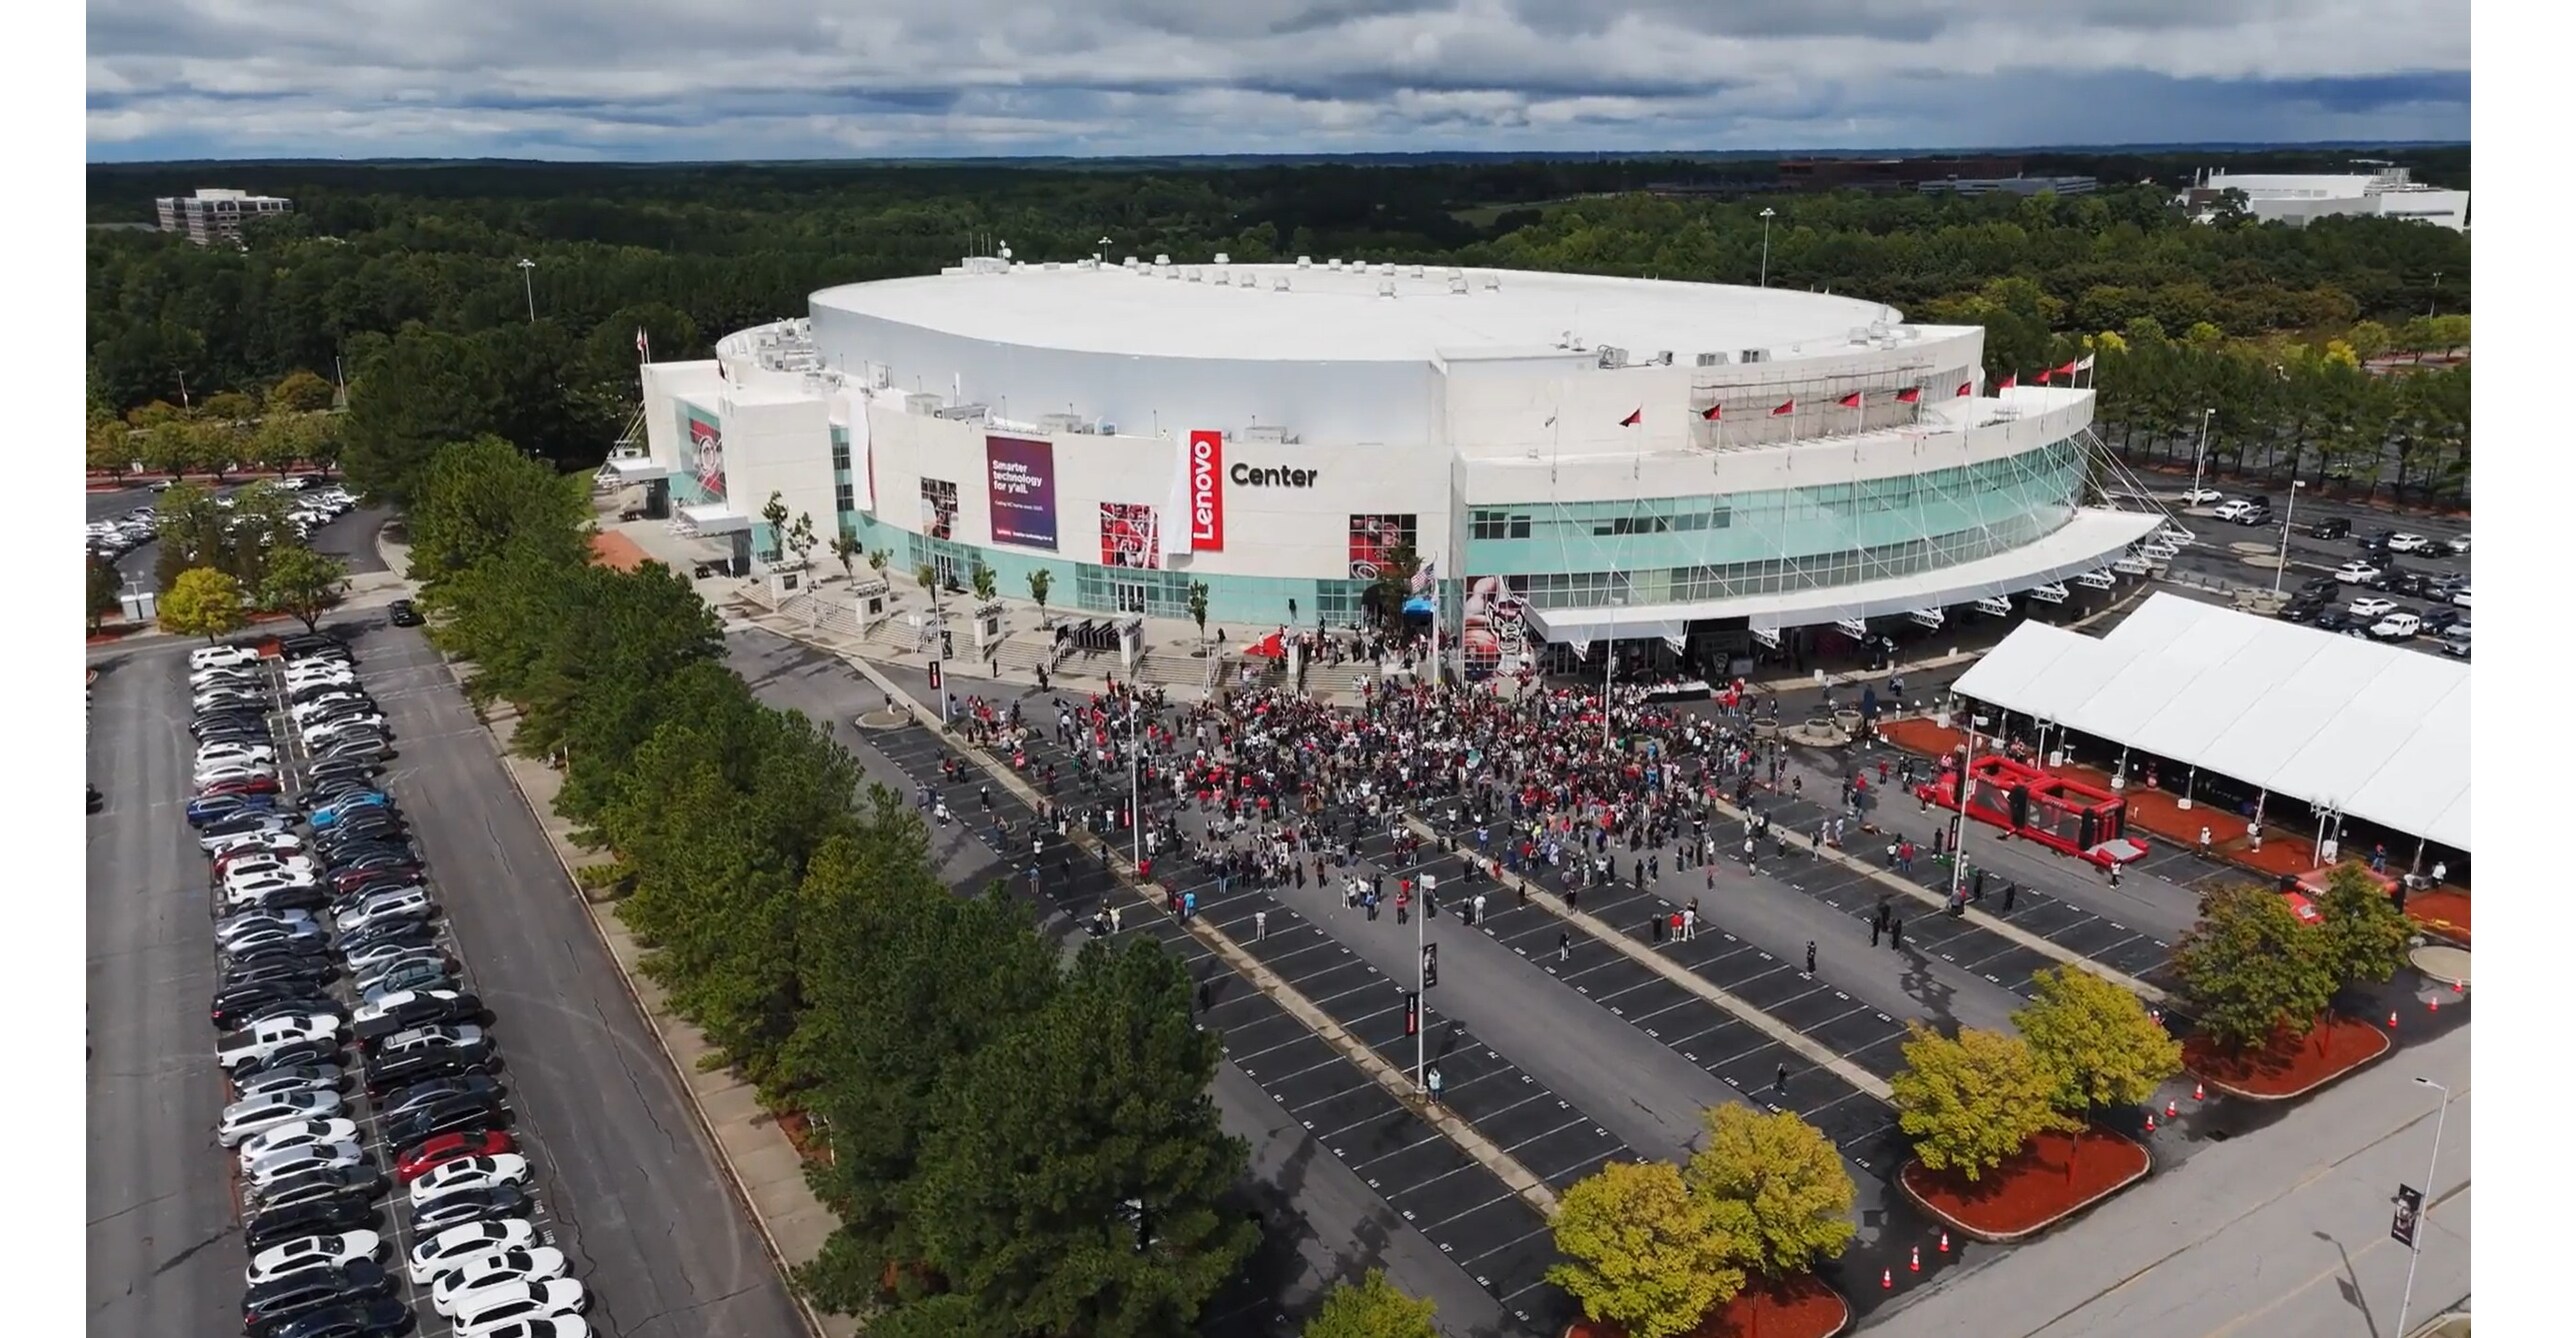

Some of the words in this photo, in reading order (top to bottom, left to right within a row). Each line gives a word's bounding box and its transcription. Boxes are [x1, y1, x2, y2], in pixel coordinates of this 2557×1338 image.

[993, 460, 1027, 473] Smarter
[993, 470, 1042, 487] technology
[1230, 462, 1318, 488] Center
[994, 480, 1006, 491] for
[1193, 440, 1213, 540] Lenovo
[1595, 1127, 1608, 1137] 73
[1333, 1148, 1345, 1157] 64
[1367, 1178, 1381, 1188] 65
[1439, 1243, 1453, 1253] 67
[1514, 1310, 1530, 1321] 69
